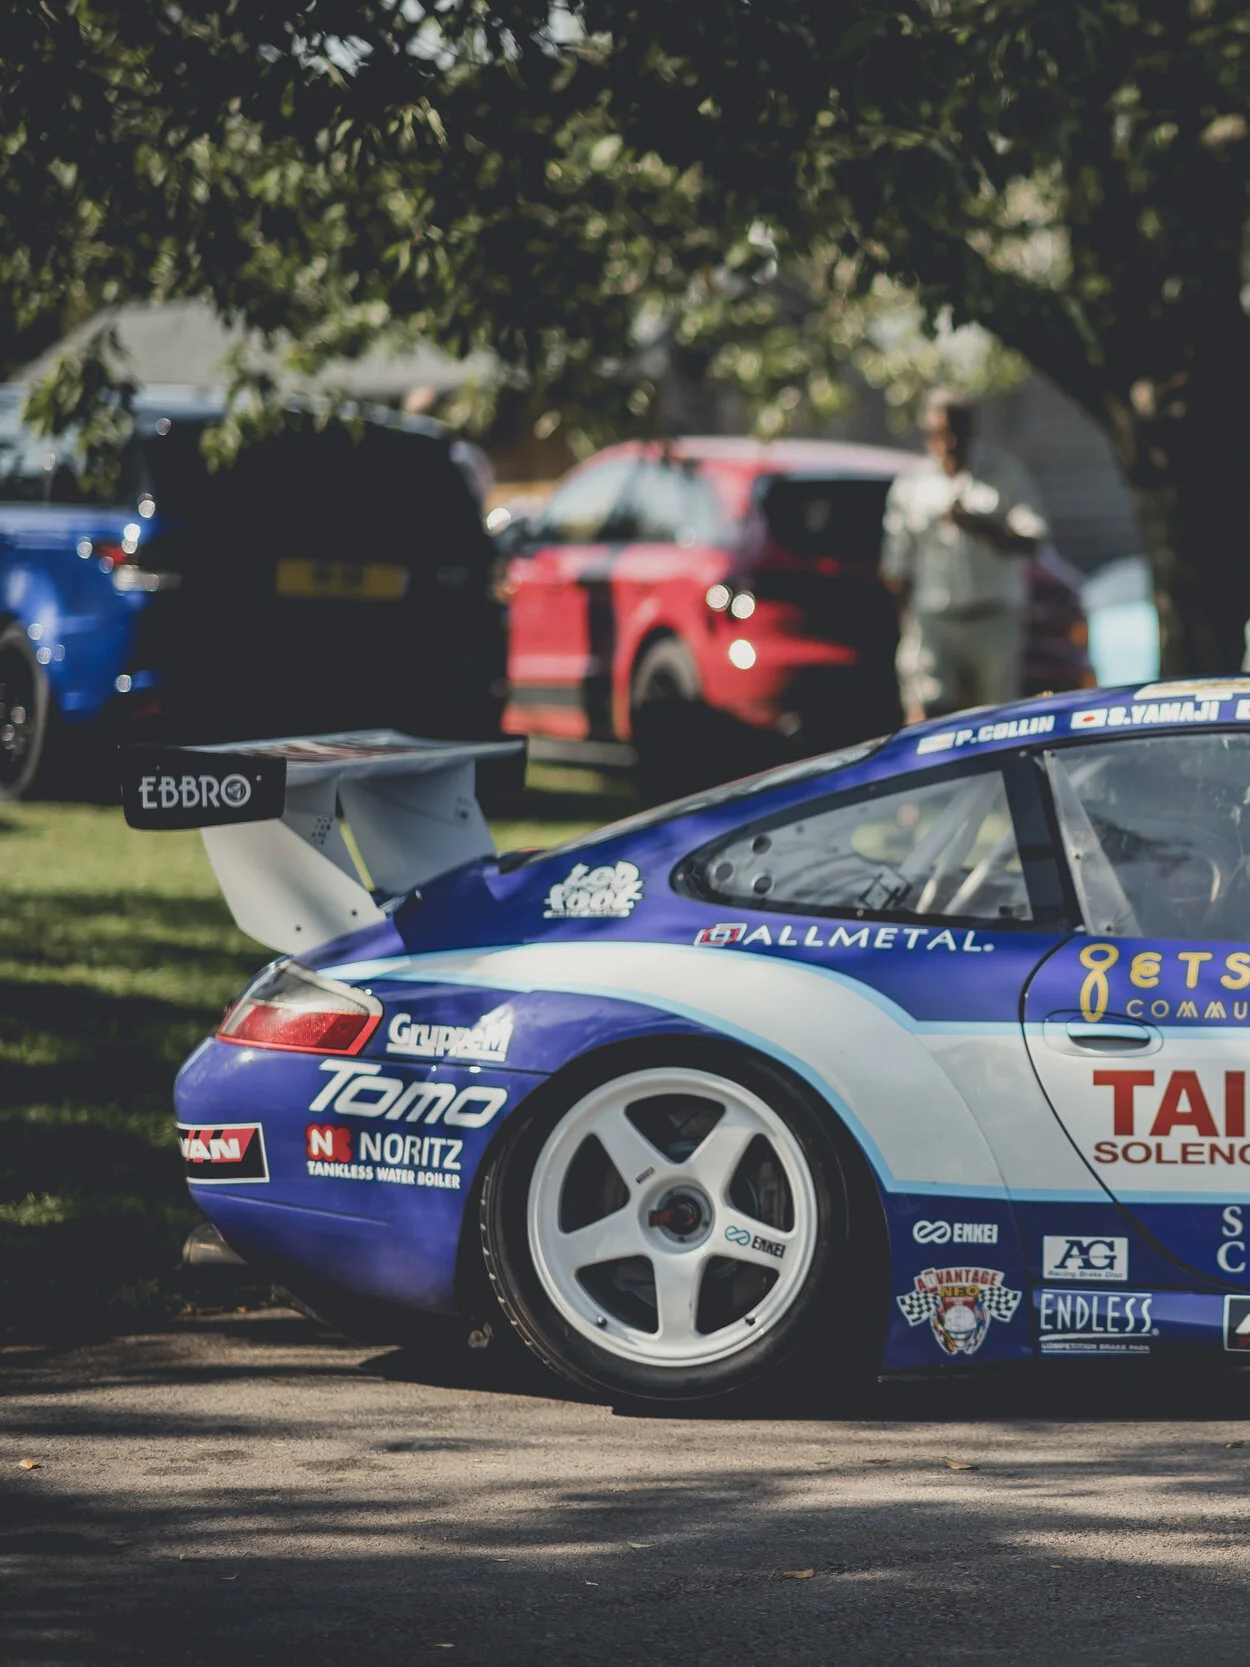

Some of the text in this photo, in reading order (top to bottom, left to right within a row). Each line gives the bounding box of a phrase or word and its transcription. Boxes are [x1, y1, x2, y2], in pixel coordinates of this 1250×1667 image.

[139, 773, 251, 809] EBBRO
[388, 1008, 513, 1058] GruppeM
[359, 1132, 463, 1170] NORITZ
[307, 1162, 461, 1189] TANKLESS WATER BOILER
[751, 1236, 786, 1258] ENKEI
[953, 1223, 998, 1244] ENKEI
[1054, 1240, 1117, 1270] AG
[1040, 1293, 1152, 1333] ENDLESS
